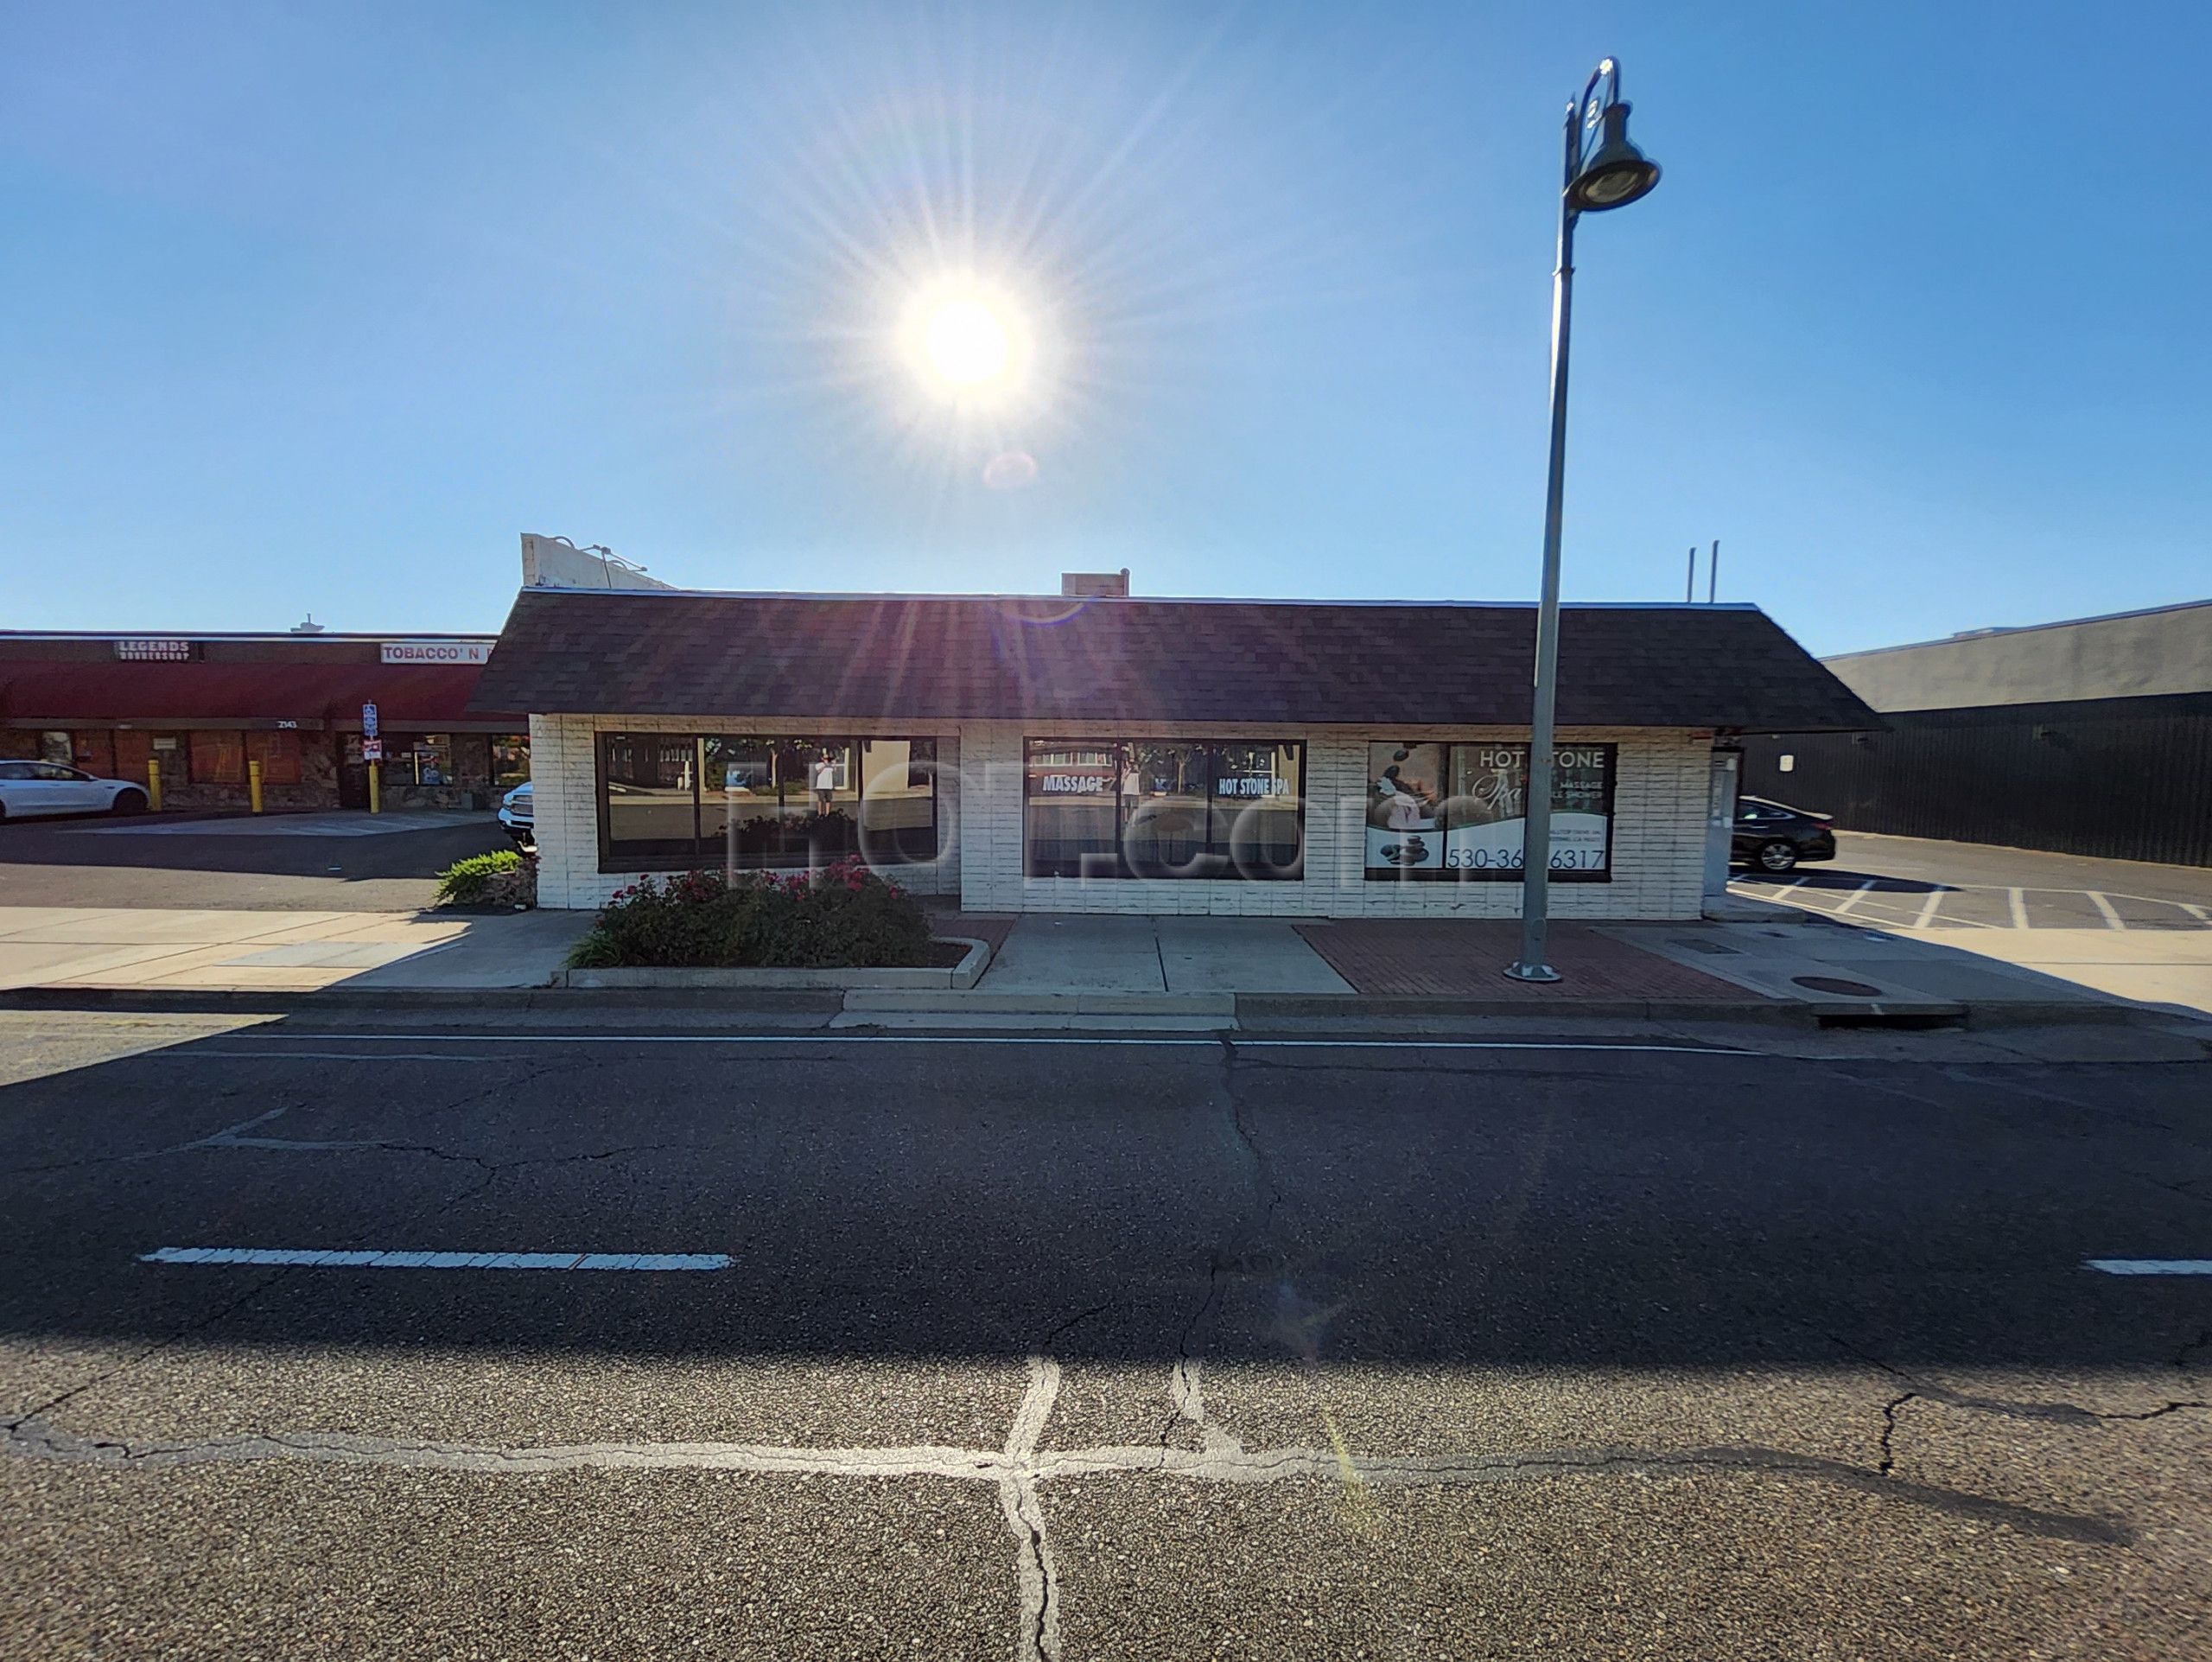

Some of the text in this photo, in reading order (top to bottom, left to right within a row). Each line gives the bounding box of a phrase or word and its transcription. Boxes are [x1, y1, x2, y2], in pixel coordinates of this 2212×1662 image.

[118, 640, 189, 652] LEGENDS
[469, 647, 479, 659] N
[1480, 750, 1605, 768] HOT TONE
[1042, 774, 1103, 793] MASSAGE
[1218, 778, 1289, 794] HOT STONE SPA
[1471, 769, 1522, 810] Spa
